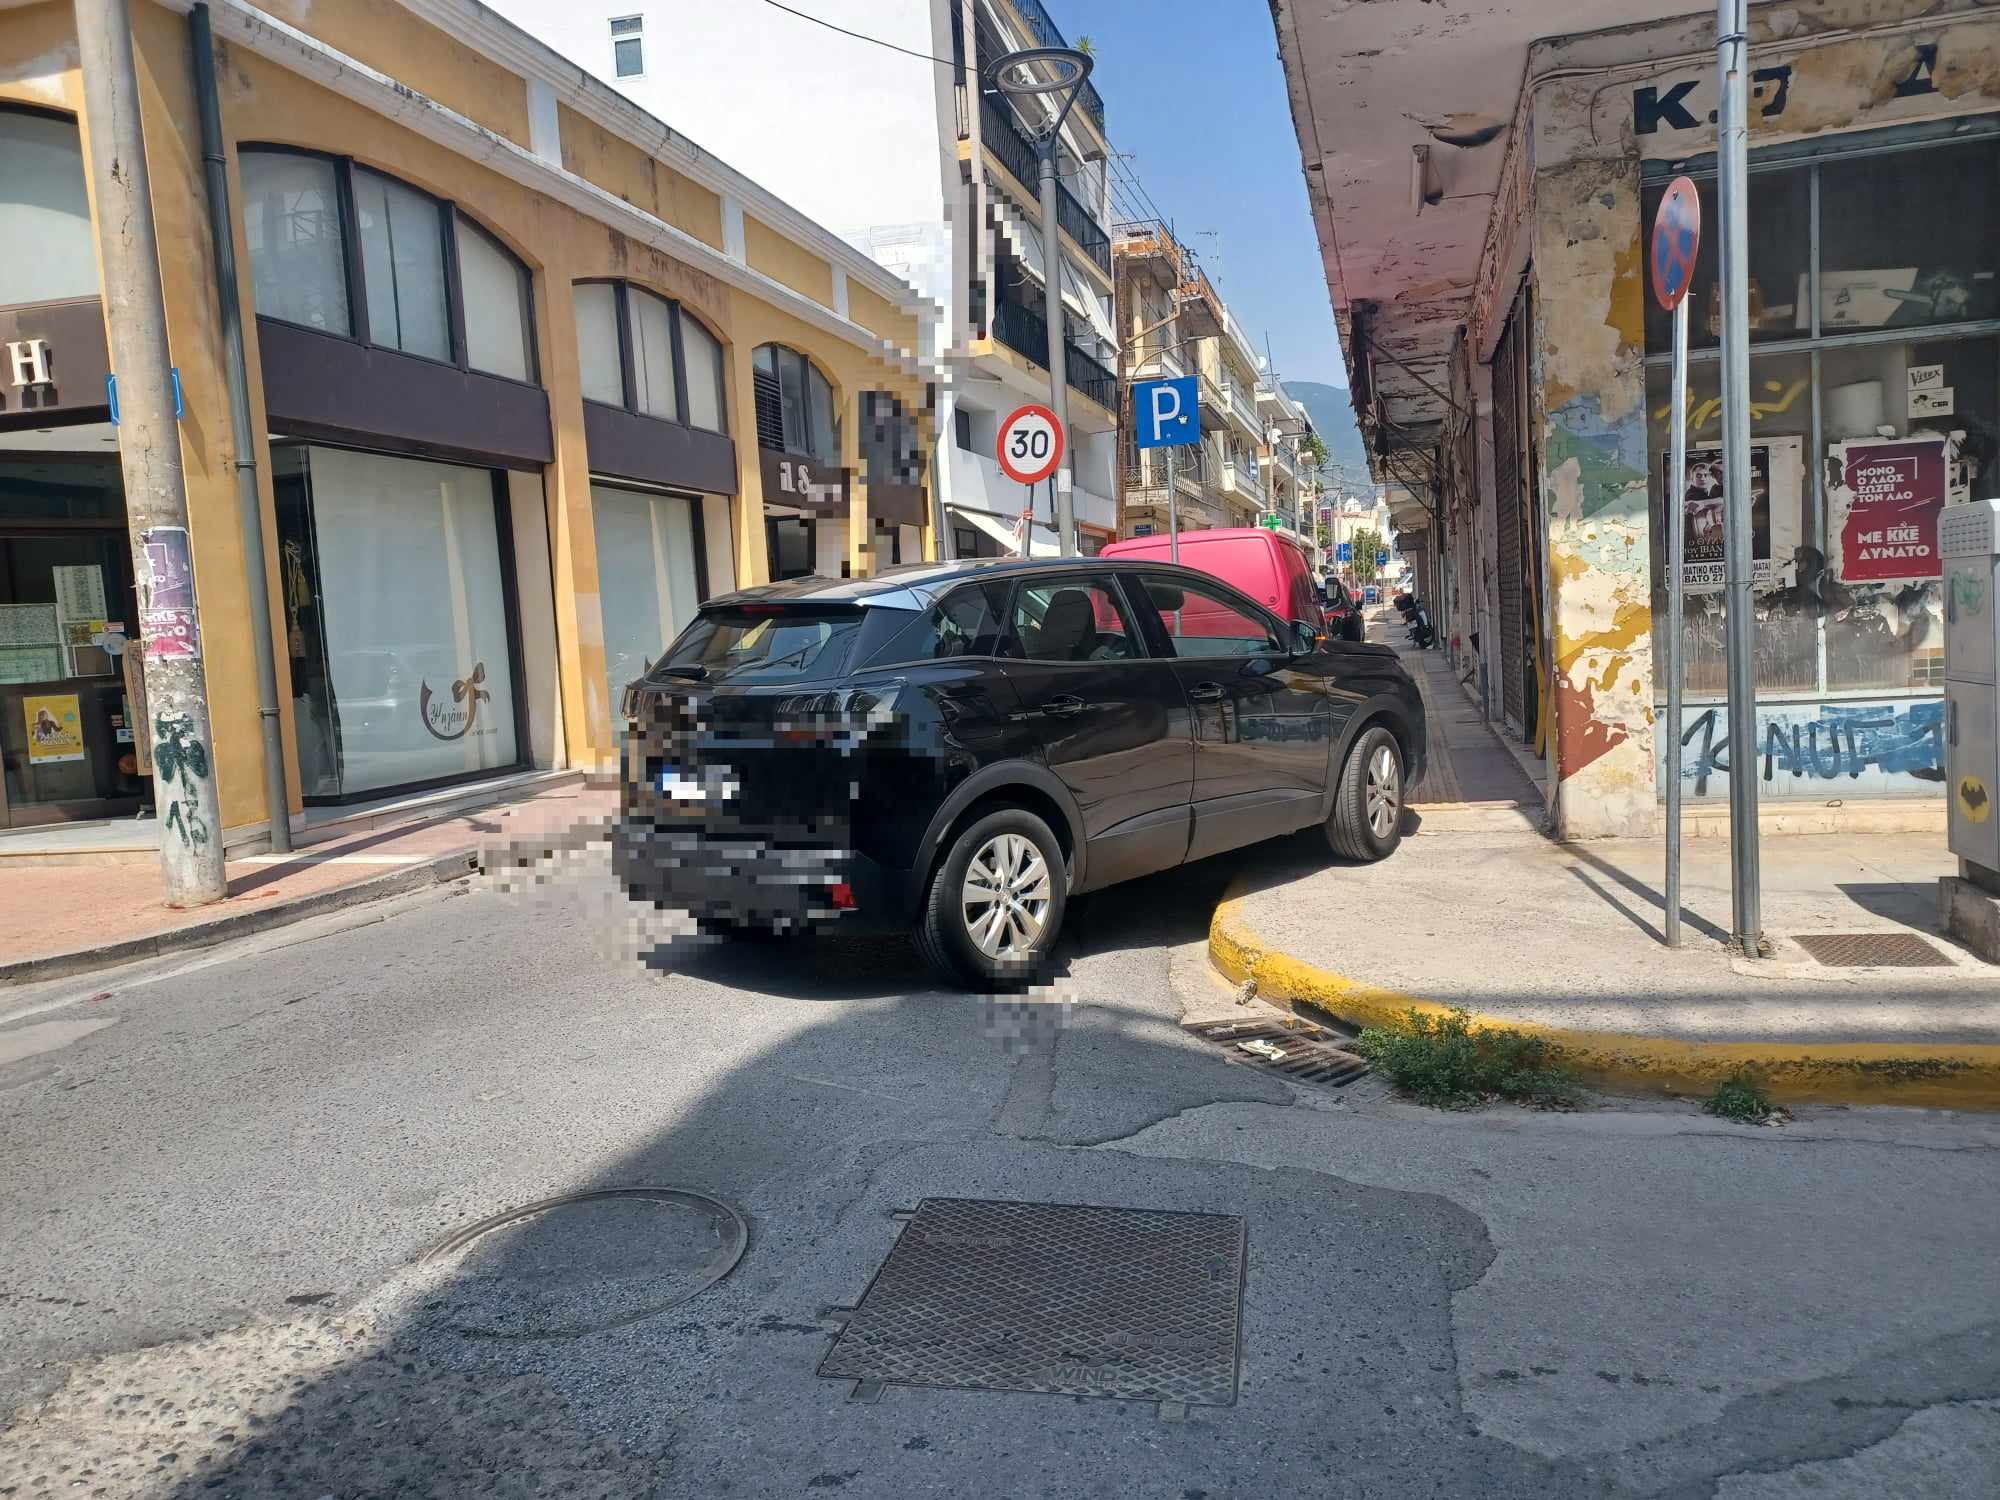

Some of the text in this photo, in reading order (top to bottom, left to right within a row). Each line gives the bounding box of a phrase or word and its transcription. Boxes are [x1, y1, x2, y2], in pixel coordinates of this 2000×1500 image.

[1152, 387, 1180, 441] P
[1011, 430, 1049, 459] 30
[1857, 466, 1895, 477] ΜΟΝΟ
[1857, 474, 1904, 486] Ο ΛΑΟΣ
[1858, 484, 1894, 494] ΣΩΖΕΙ
[1858, 491, 1913, 503] ΤΟΝ ΛΑΟ
[1857, 527, 1919, 544] ΜΕ ΚΚΕ
[1858, 545, 1930, 560] ΔΥΝΑΤΟ
